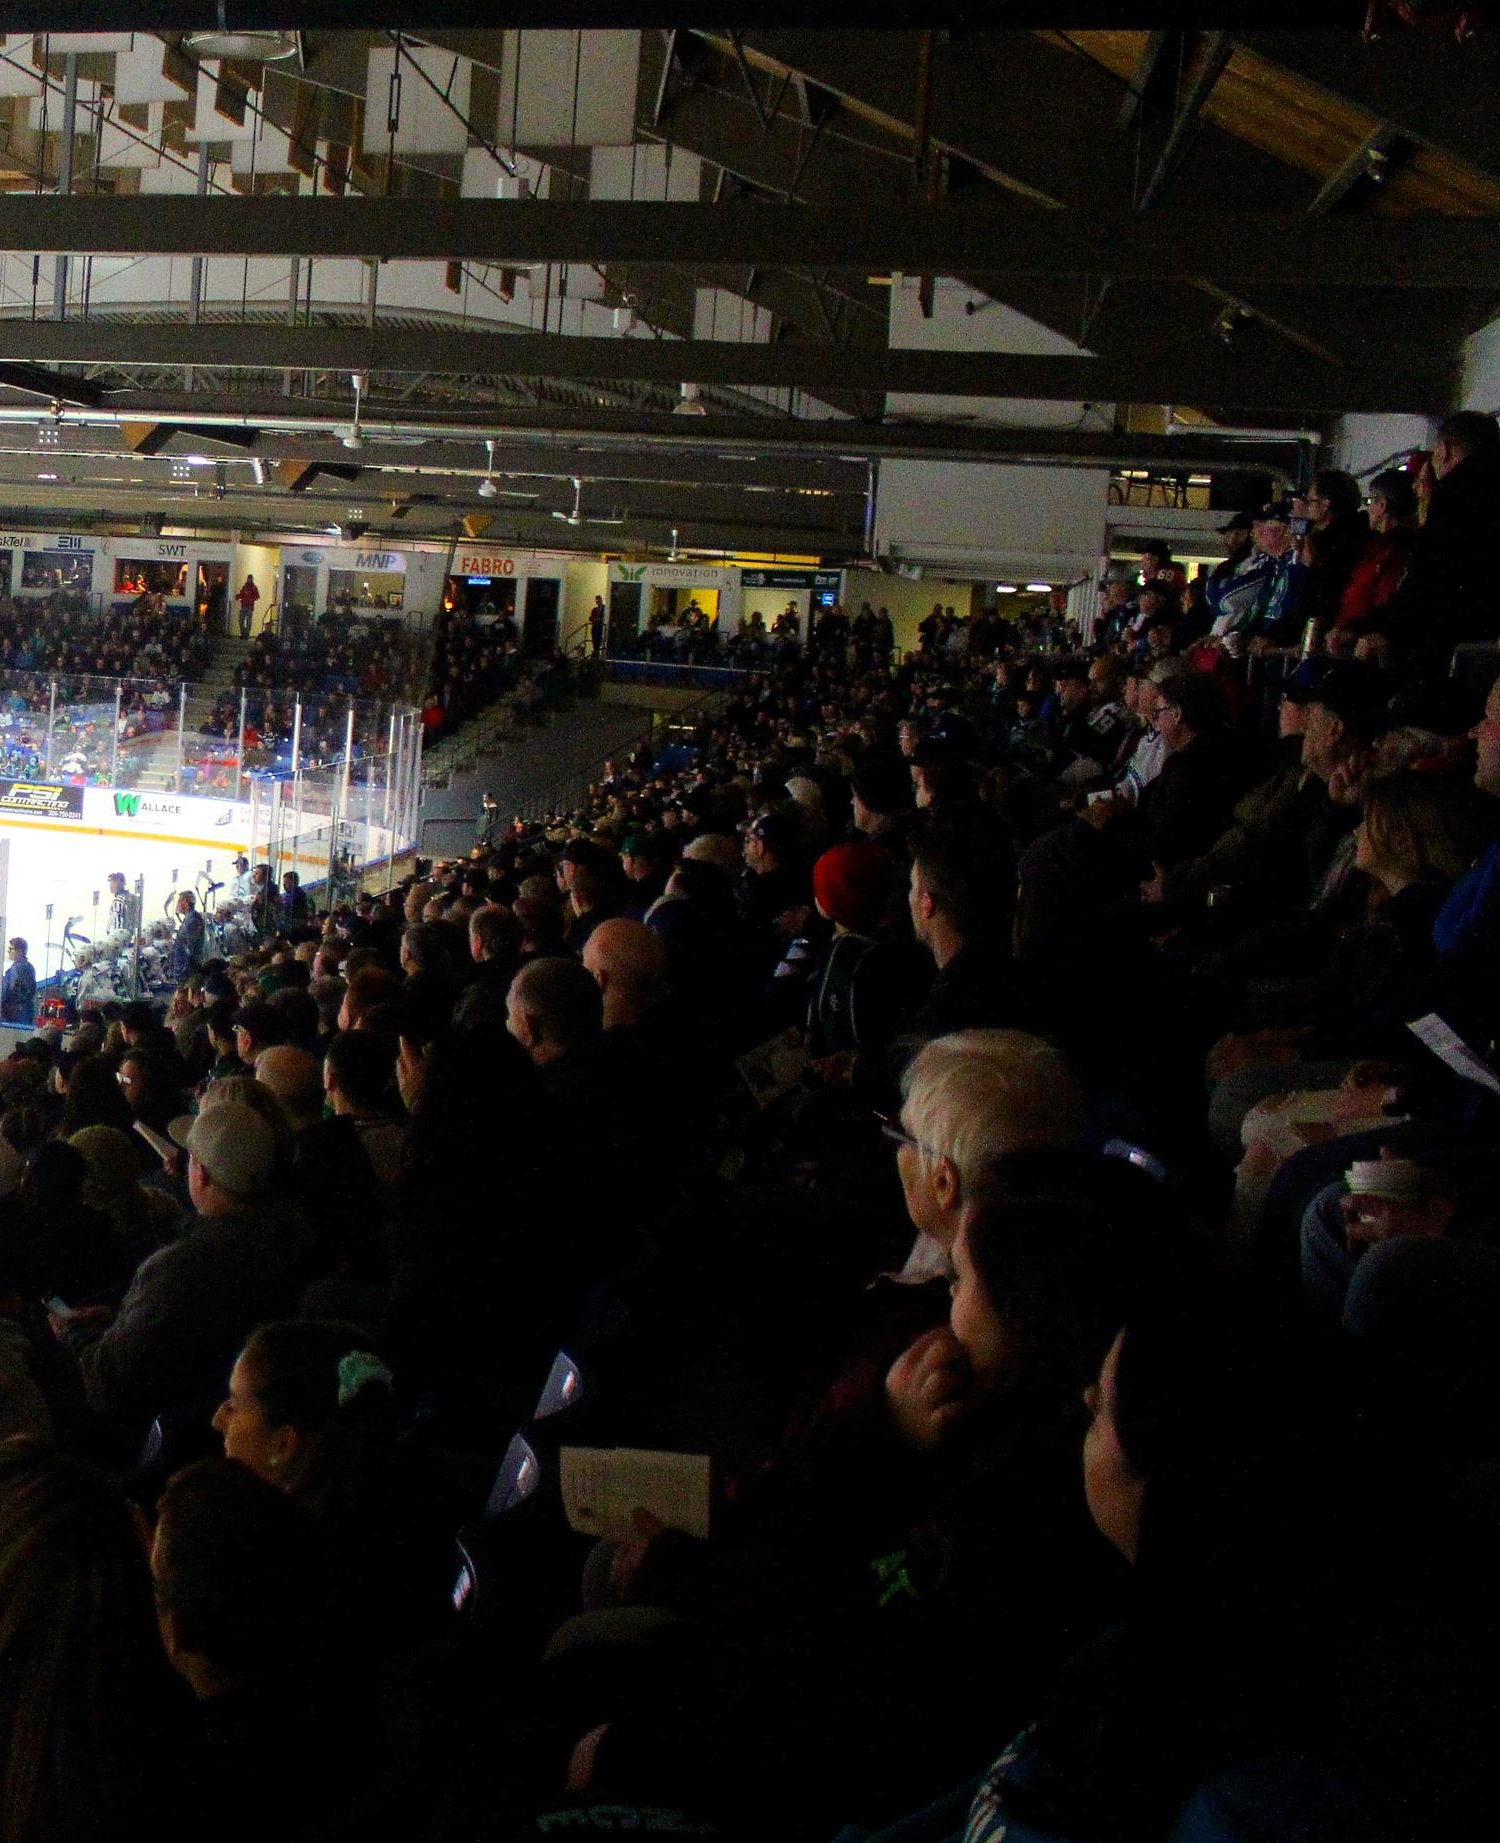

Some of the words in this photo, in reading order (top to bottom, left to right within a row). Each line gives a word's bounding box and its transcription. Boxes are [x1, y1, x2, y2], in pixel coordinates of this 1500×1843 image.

[158, 543, 187, 556] SWT
[355, 552, 397, 570] MNP
[461, 557, 516, 576] FABRO
[651, 565, 719, 578] innovation
[8, 783, 63, 801] PSI
[0, 795, 70, 809] CONTRACTING
[113, 792, 181, 818] WALLACE
